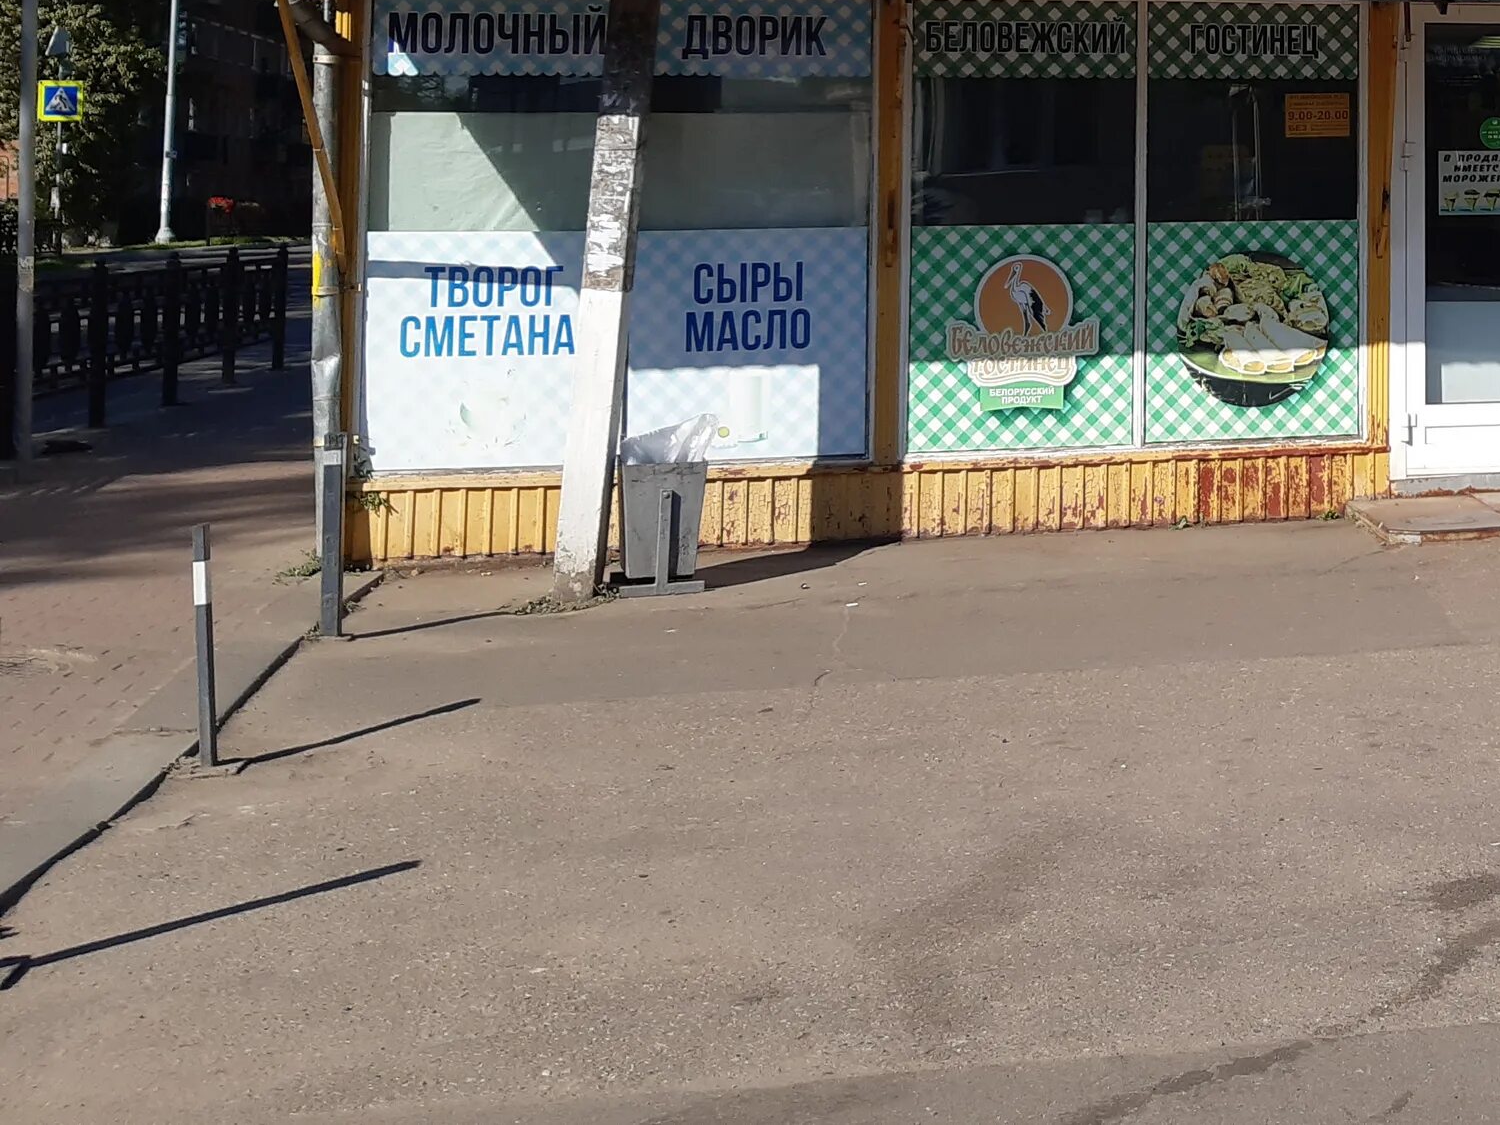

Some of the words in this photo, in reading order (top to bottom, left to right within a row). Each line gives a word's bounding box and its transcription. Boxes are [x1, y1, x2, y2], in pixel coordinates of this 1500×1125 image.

[388, 5, 608, 56] МОЛОЧНЫЙ
[682, 14, 827, 60] ДВОРИК
[925, 17, 1127, 54] БЕЛОВЕЖСКИЙ
[1190, 23, 1320, 59] ГОСТИНЕЦ
[424, 265, 564, 308] ТВОРОГ
[694, 261, 804, 304] СЫРЫ
[400, 313, 576, 358] СМЕТАНА
[685, 308, 811, 352] МАСЛО
[989, 386, 1054, 397] БЕЛОРУССКИЙ
[1002, 395, 1042, 405] ПРОДУКТ
